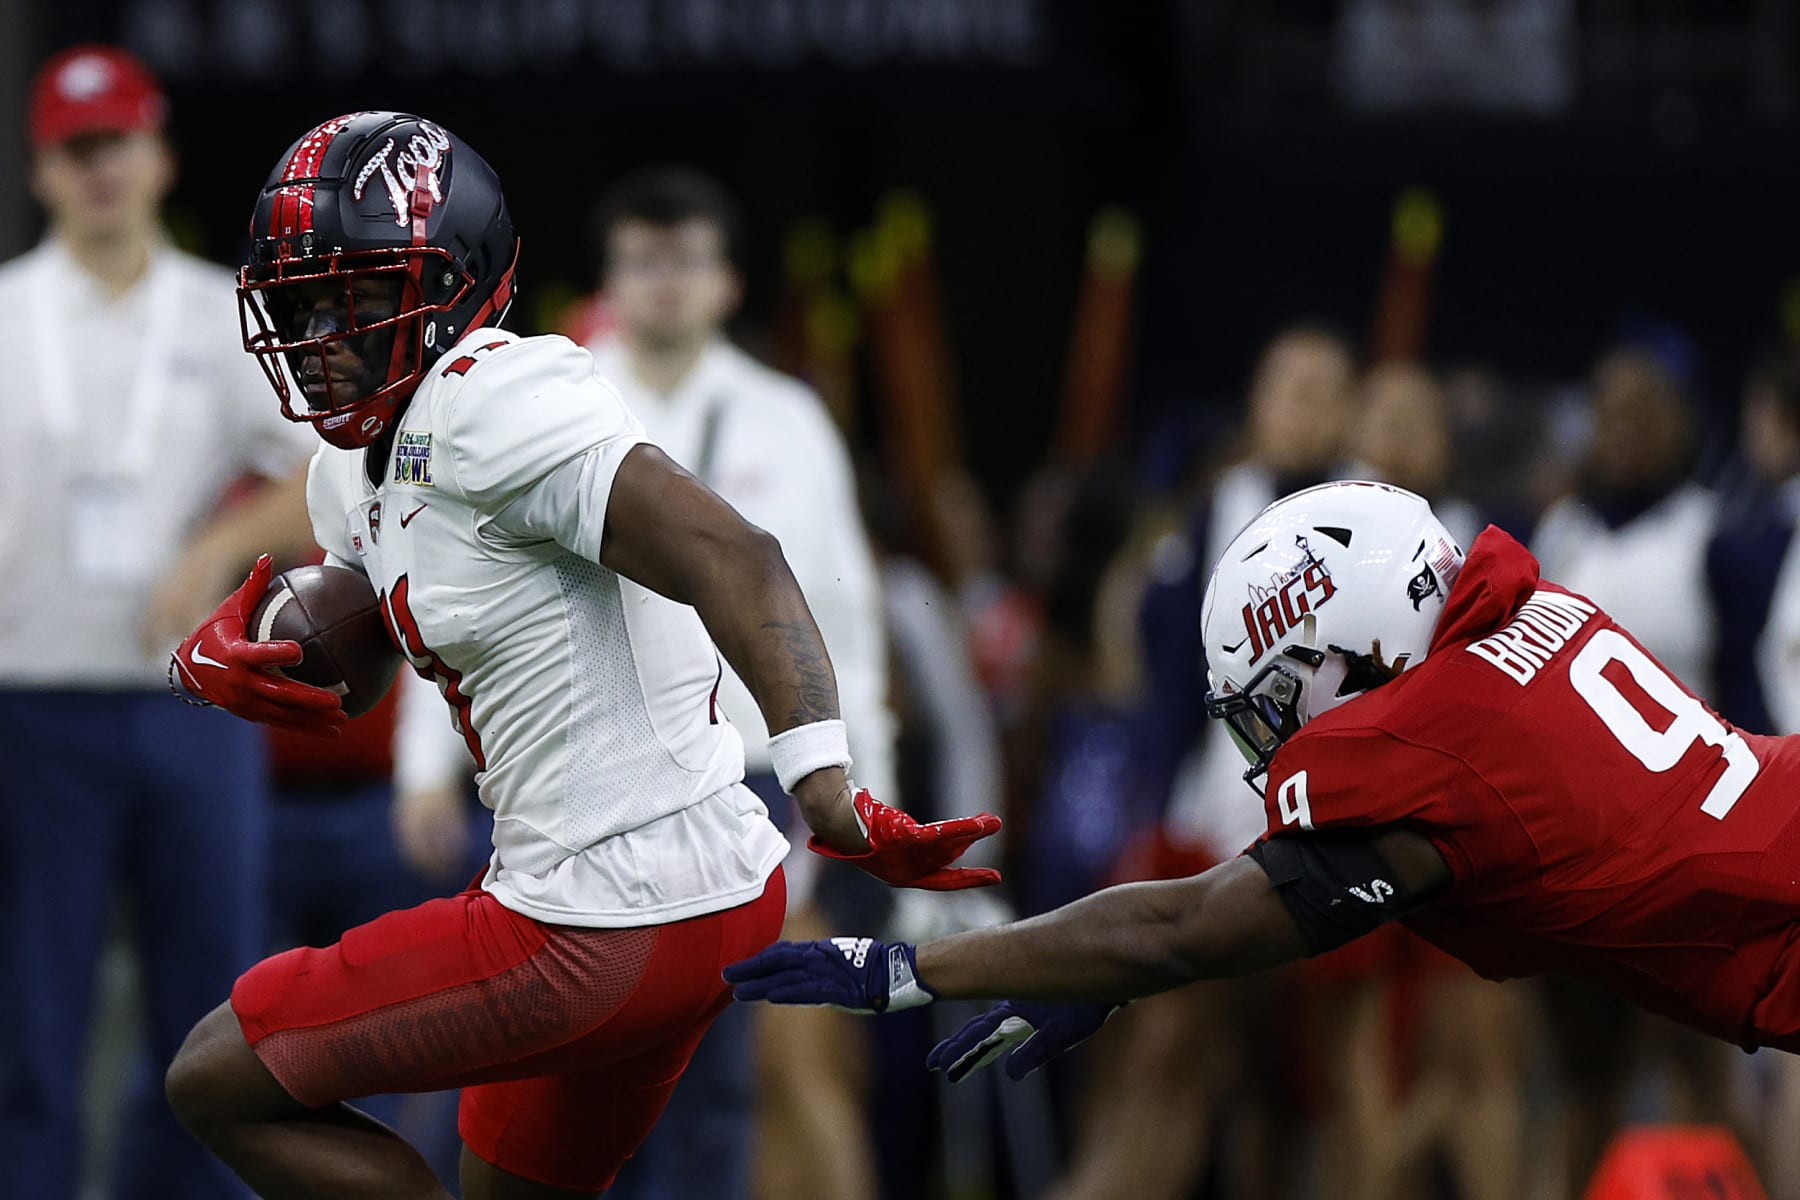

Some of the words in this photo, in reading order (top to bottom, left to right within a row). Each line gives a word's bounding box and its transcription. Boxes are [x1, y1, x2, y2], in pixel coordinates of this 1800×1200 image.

[394, 457, 432, 483] BOWL
[1241, 560, 1338, 667] JAGS
[1465, 590, 1598, 687] BROWN
[1568, 628, 1761, 821] 9
[1277, 769, 1315, 831] 9
